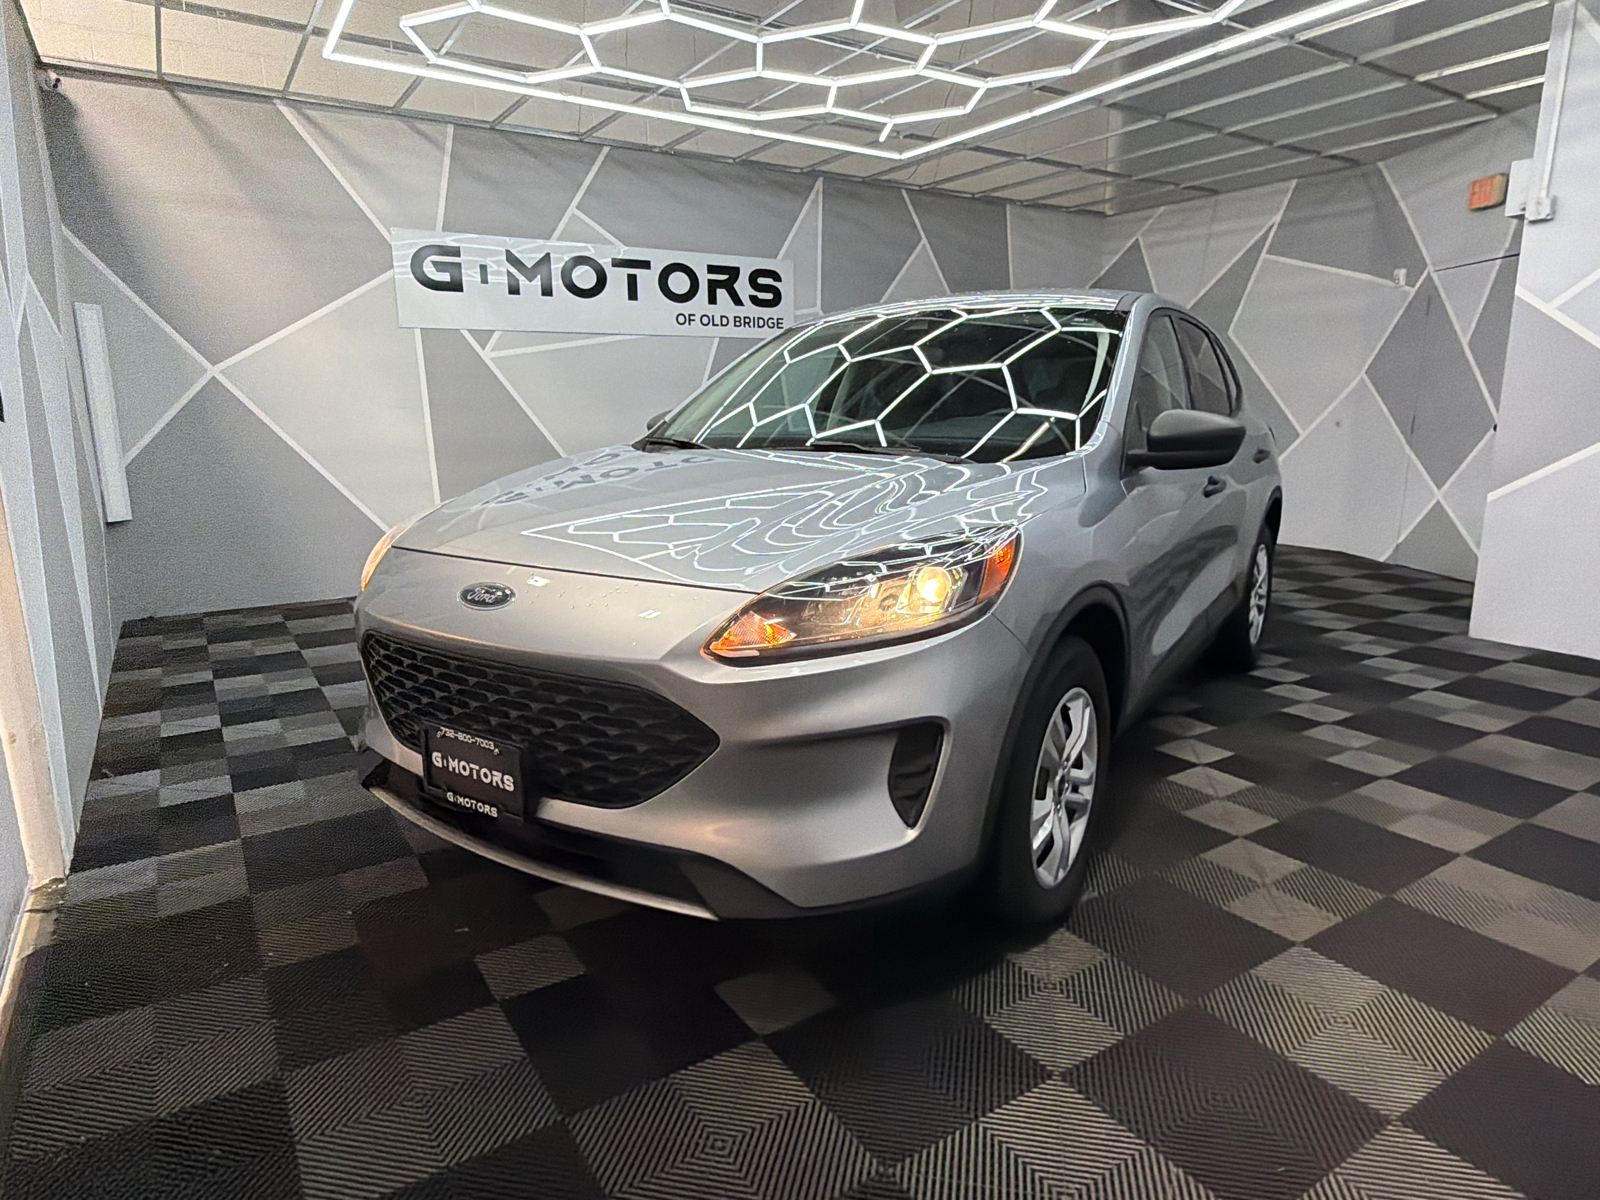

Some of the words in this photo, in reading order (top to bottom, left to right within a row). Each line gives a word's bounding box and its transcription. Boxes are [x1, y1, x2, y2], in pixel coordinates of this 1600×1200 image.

[676, 314, 696, 326] OF
[700, 315, 730, 328] OLD
[733, 317, 784, 329] BRIDGE
[467, 586, 499, 603] Ford
